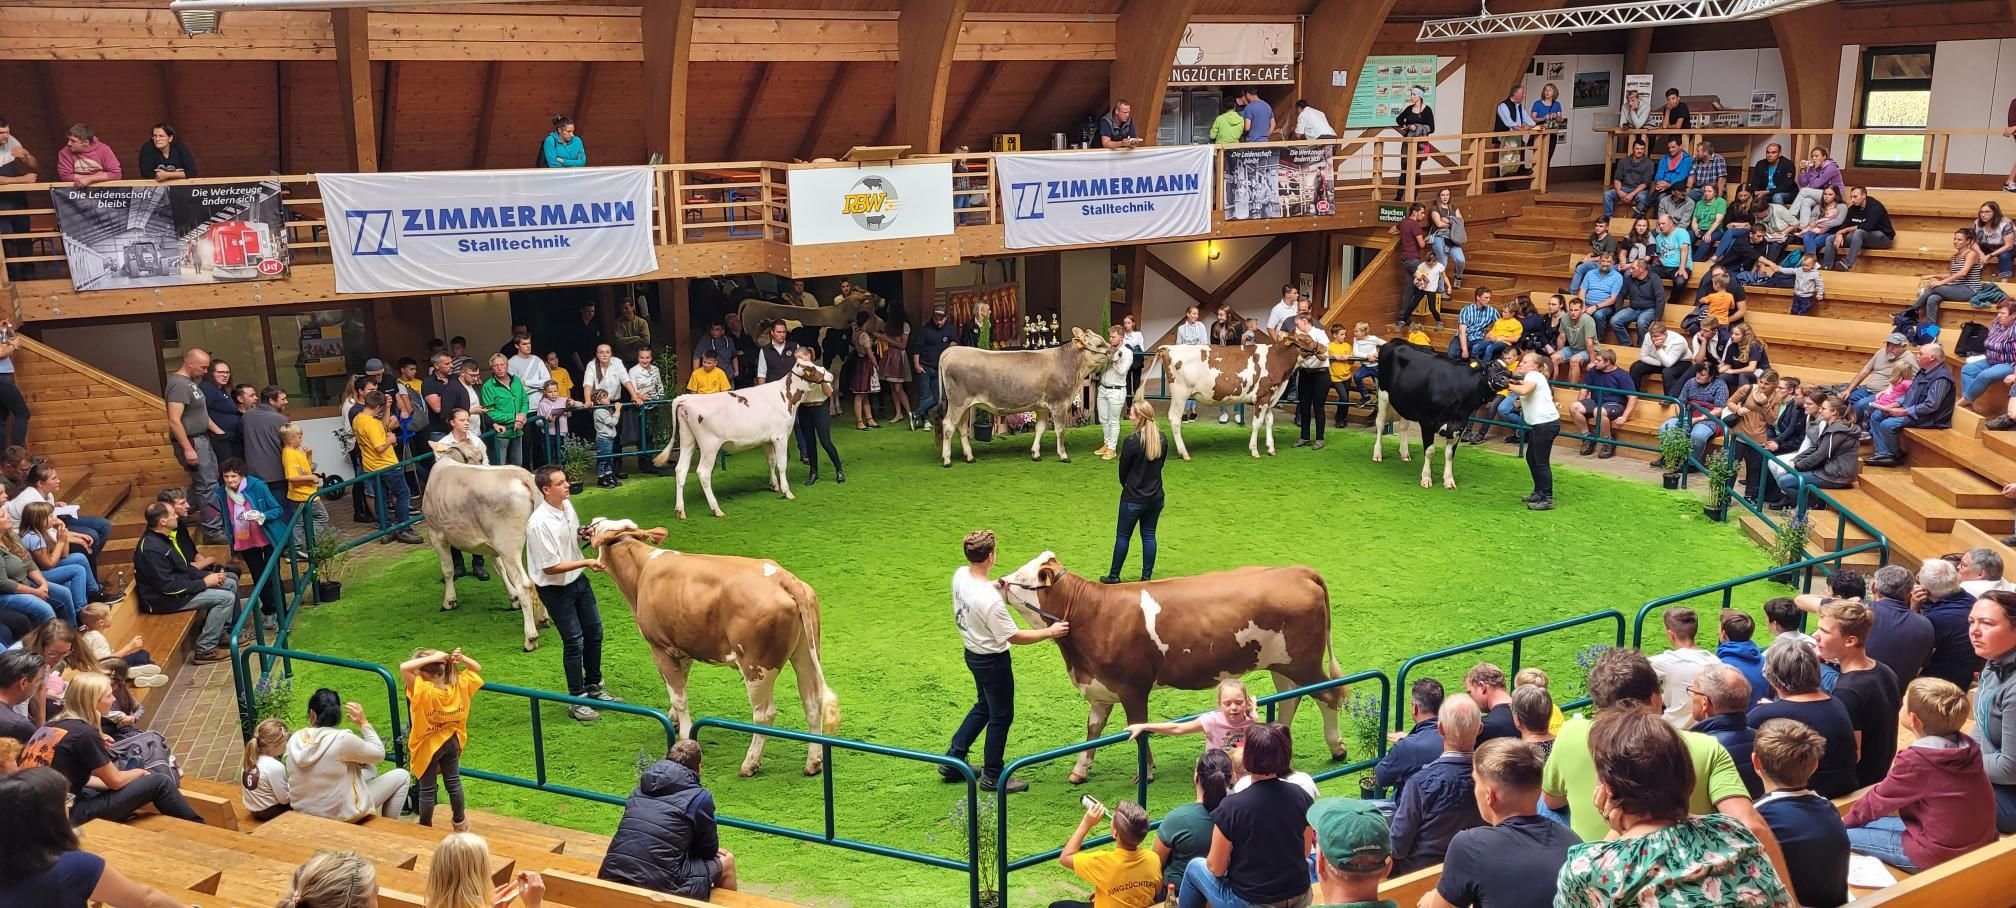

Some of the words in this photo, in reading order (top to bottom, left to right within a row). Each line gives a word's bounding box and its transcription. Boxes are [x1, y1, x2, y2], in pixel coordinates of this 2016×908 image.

[1168, 65, 1289, 81] NGZÜCHTER-CAFÉ
[191, 188, 208, 197] Die
[210, 186, 263, 196] Werkzeuge
[1047, 173, 1199, 199] ZIMMERMANN
[69, 191, 86, 200] Die
[88, 189, 152, 200] Leidenschaft
[202, 197, 235, 206] ändern
[236, 195, 255, 204] sich
[97, 199, 127, 209] bleibt
[842, 192, 887, 214] RBW
[1081, 201, 1155, 216] Stalltechnik
[402, 200, 635, 231] ZIMMERMANN
[457, 234, 570, 253] Stalltechnik
[247, 774, 253, 787] 6
